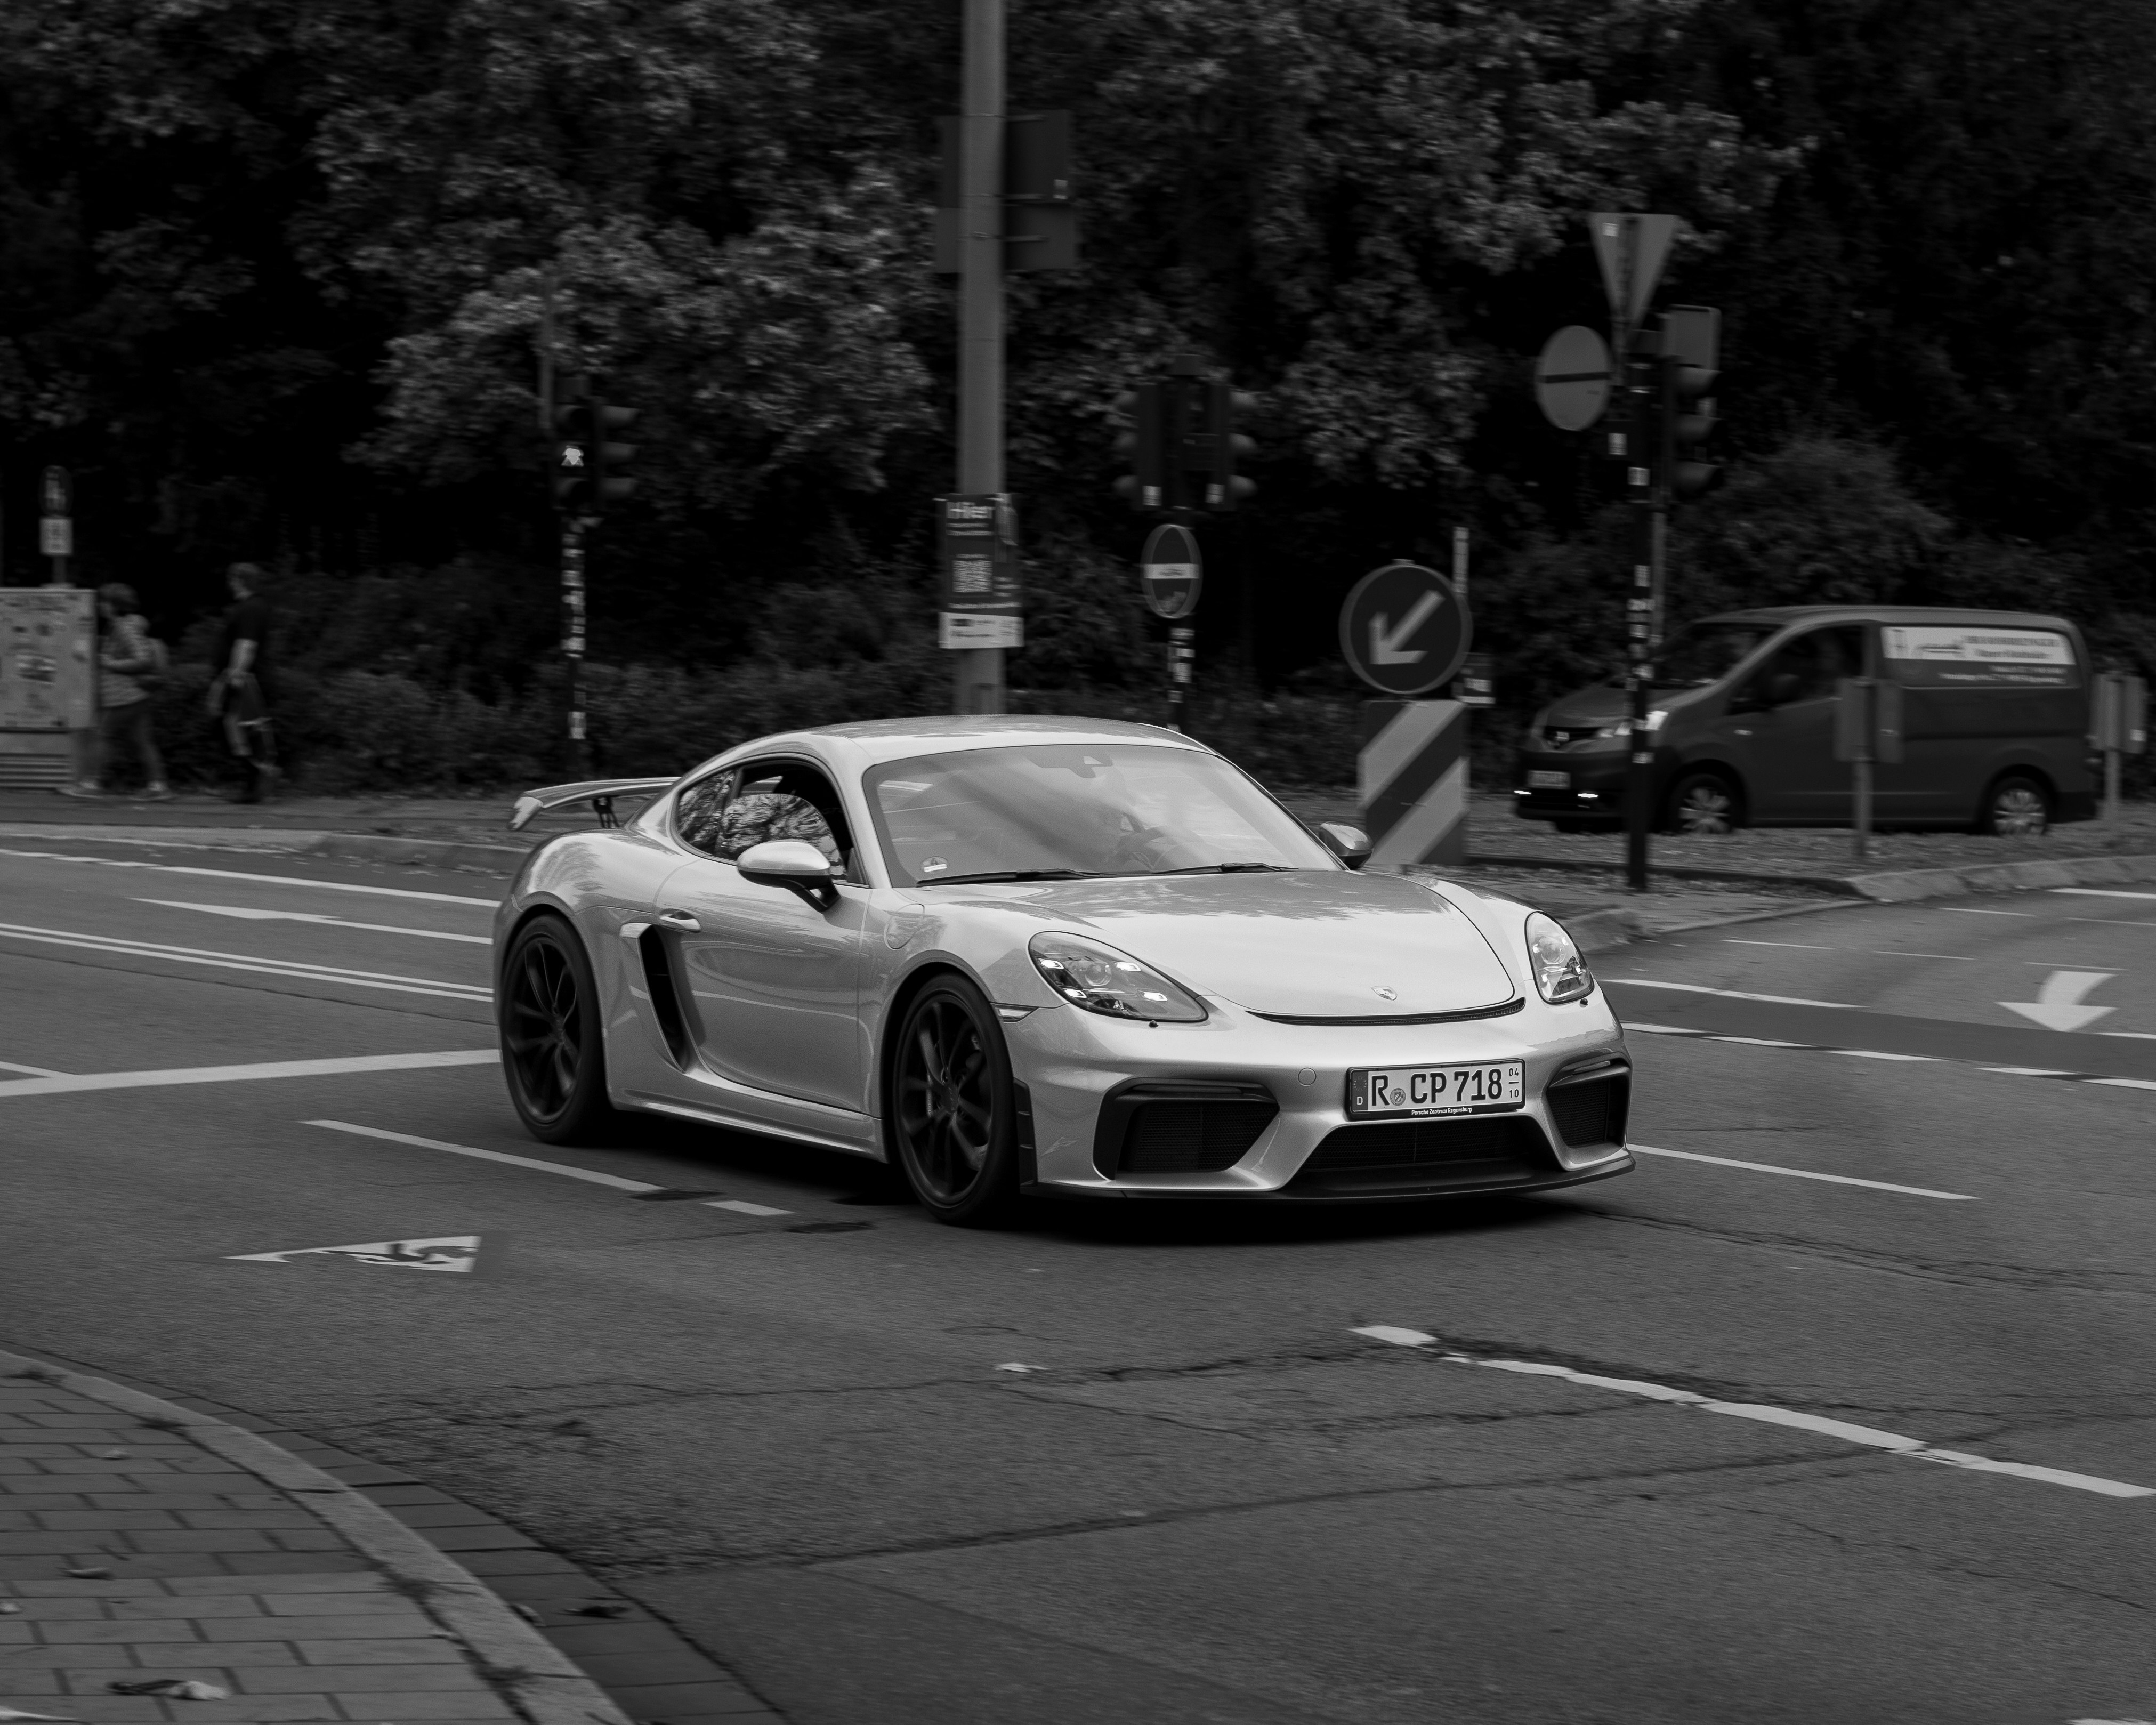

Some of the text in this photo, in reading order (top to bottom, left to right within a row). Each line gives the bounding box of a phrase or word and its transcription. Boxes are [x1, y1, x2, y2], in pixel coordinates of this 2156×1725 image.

[1508, 1067, 1519, 1076] 04
[1372, 1075, 1390, 1106] R
[1411, 1072, 1447, 1104] CP
[1454, 1068, 1503, 1102] 718
[1509, 1089, 1519, 1099] 10
[1356, 1097, 1363, 1106] D
